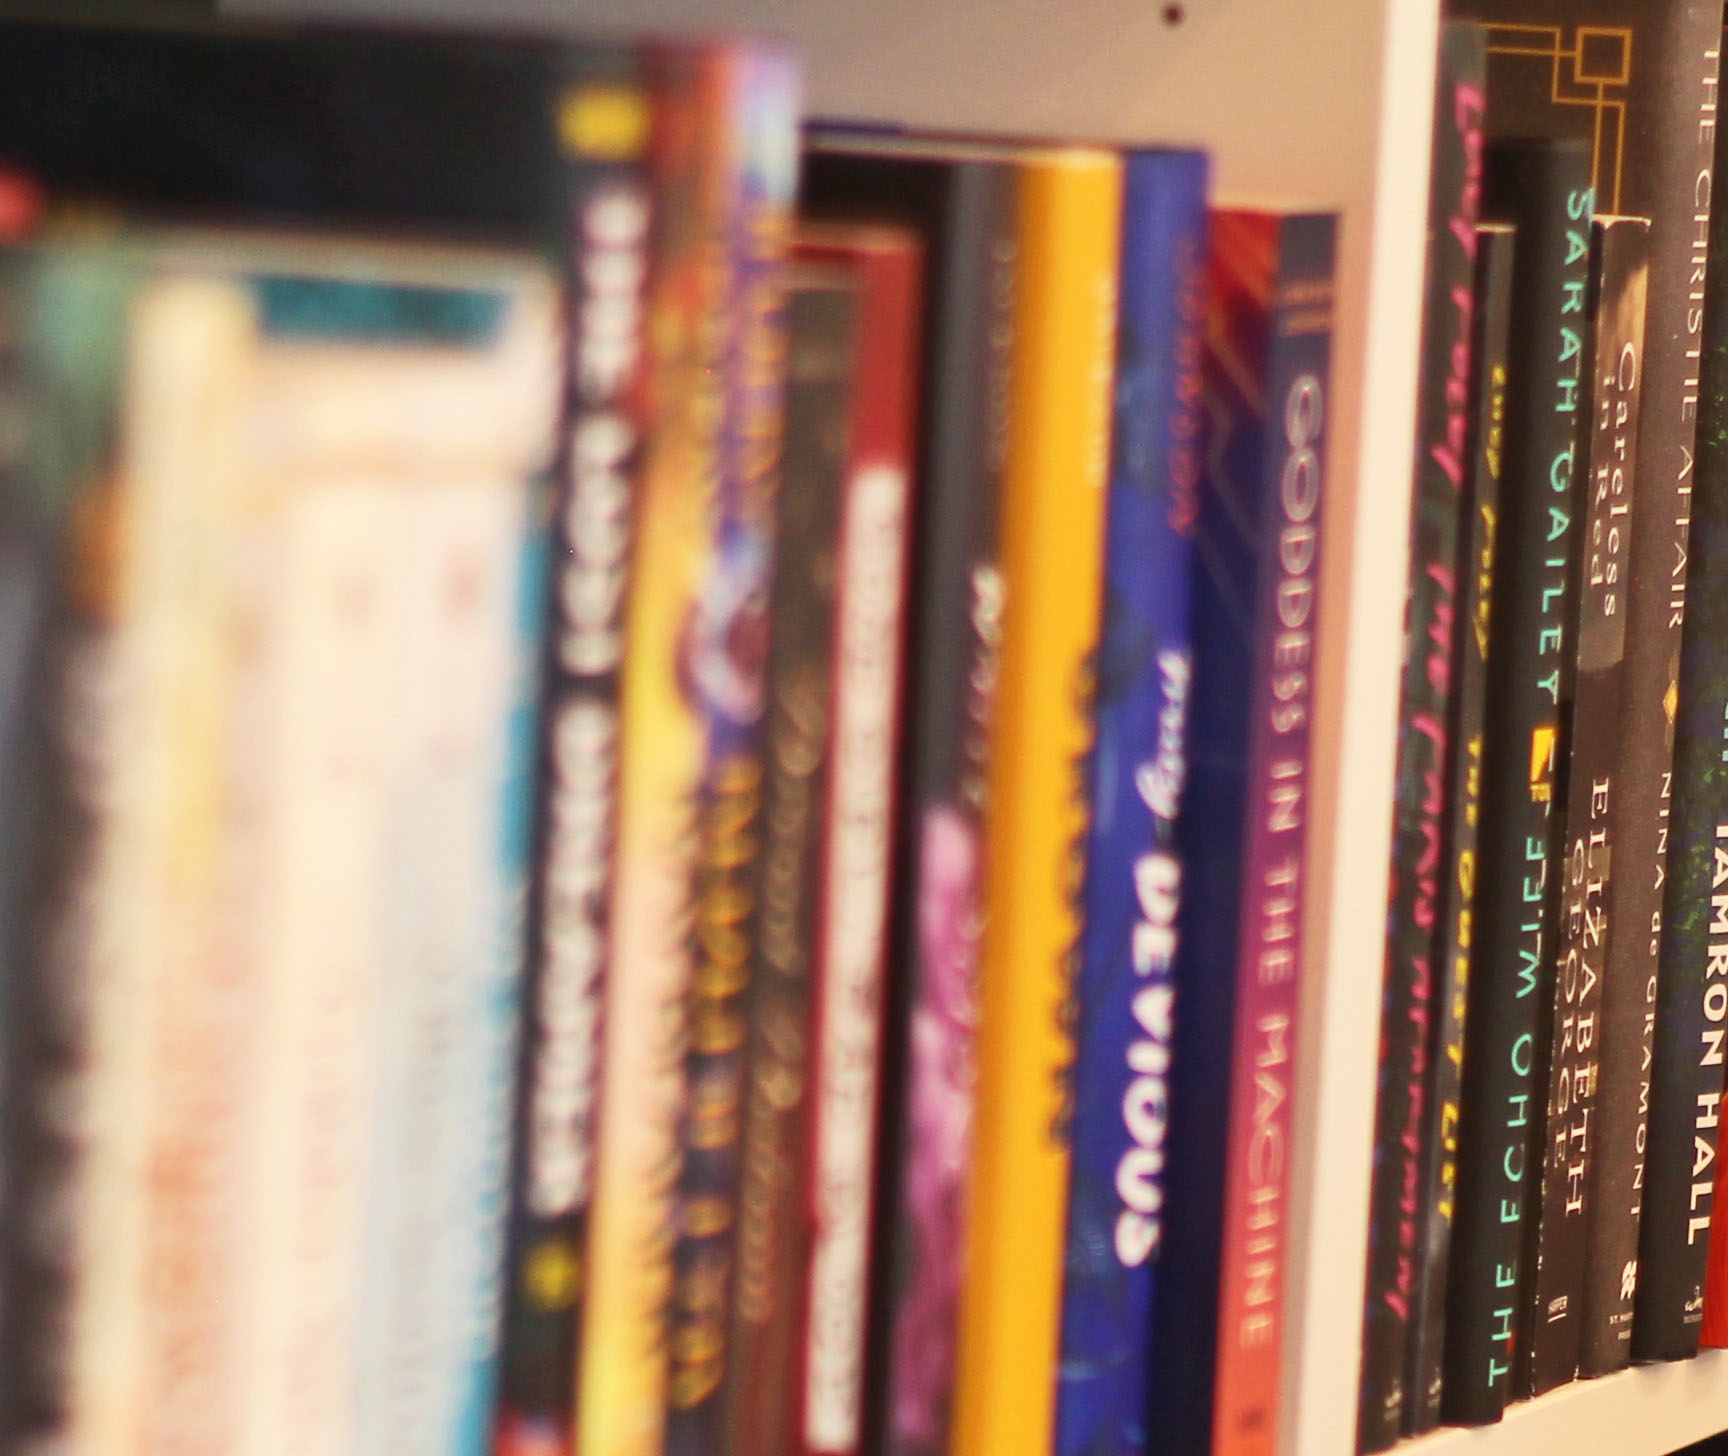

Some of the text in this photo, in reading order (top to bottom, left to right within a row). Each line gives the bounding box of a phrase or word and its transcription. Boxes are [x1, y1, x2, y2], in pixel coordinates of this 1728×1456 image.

[1534, 188, 1593, 705] SARAH GAILEY
[1586, 374, 1616, 588] in Red
[1597, 341, 1641, 617] Careless
[1667, 40, 1722, 630] THE CHRISTIE AFFAIR
[1110, 855, 1183, 1268] DEVIOUS
[1236, 375, 1325, 1355] GODDESS IN THE MACHINE
[1551, 838, 1587, 1168] GEORGE
[1563, 777, 1611, 1216] ELIZABETH
[1629, 770, 1672, 1222] NINA de GRAMONT
[1487, 836, 1547, 1389] THE ECHO WIFE
[1686, 1093, 1719, 1242] HALL
